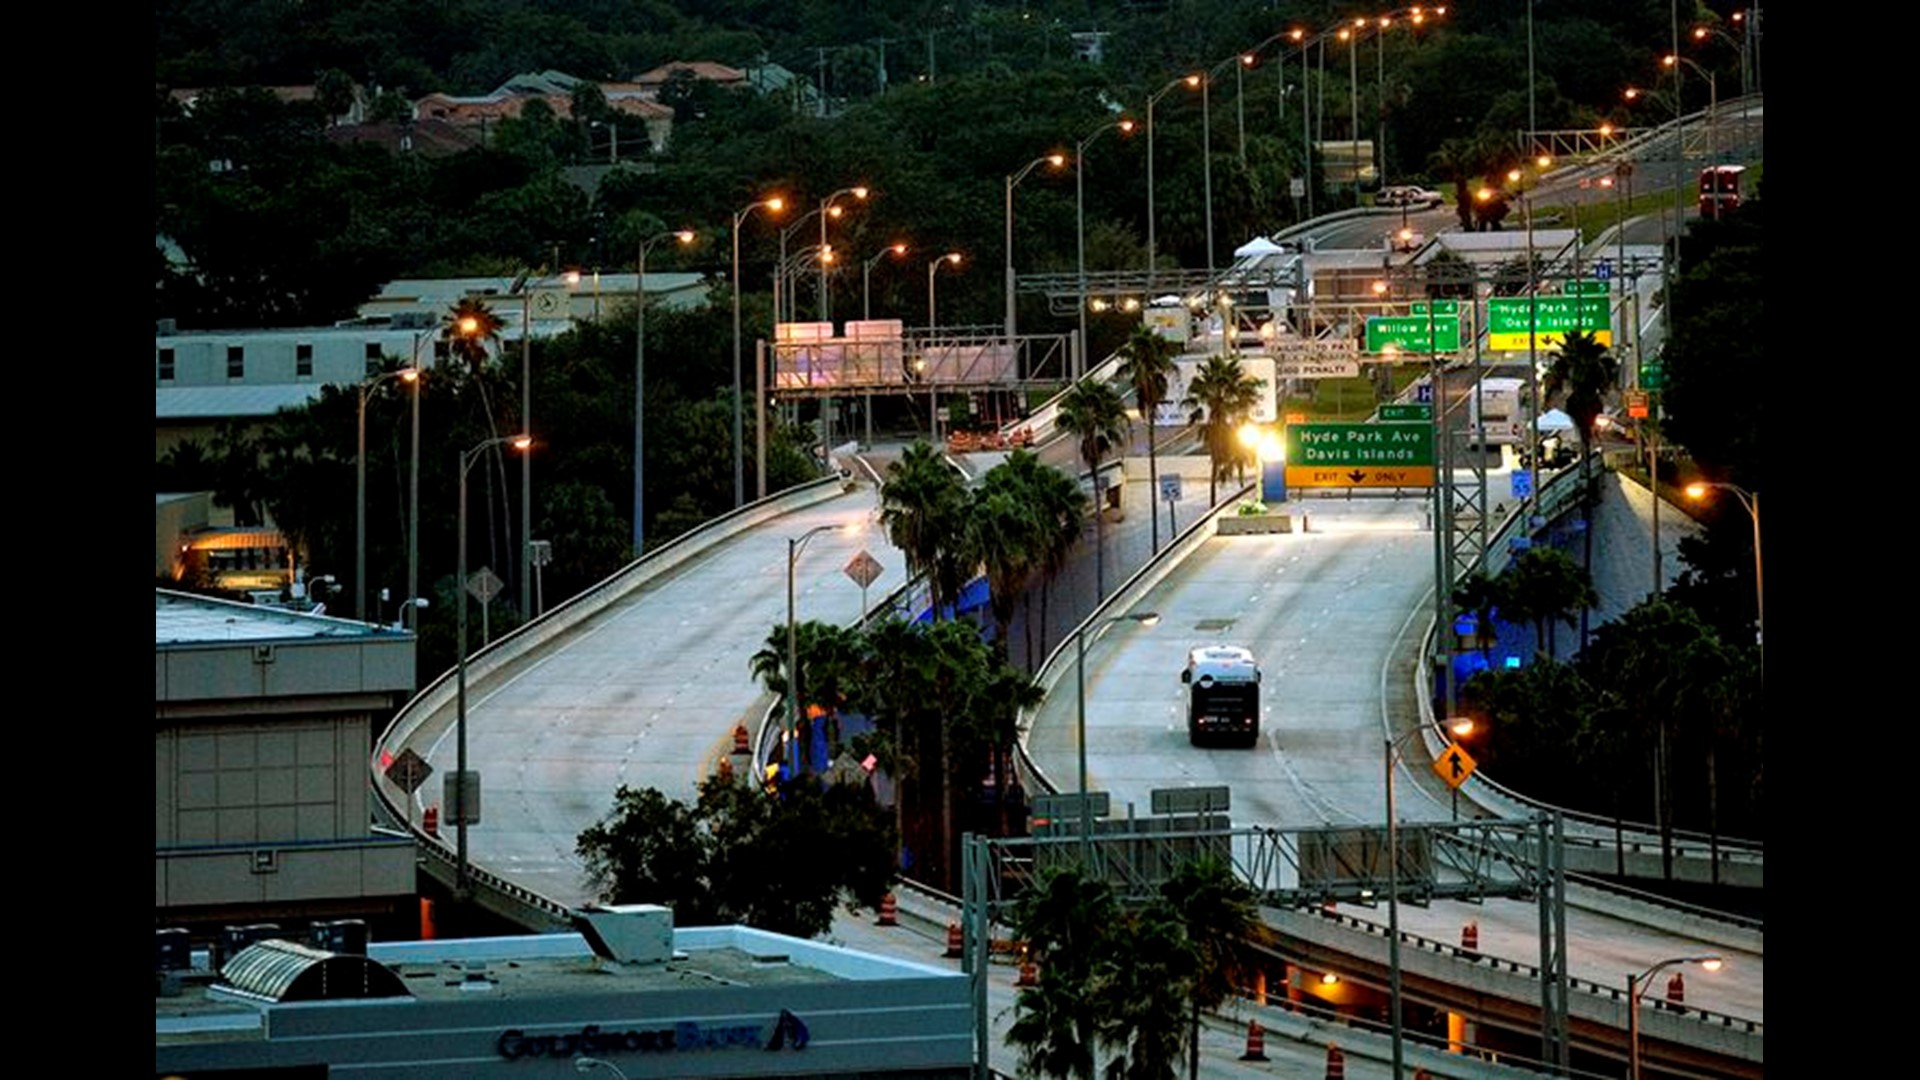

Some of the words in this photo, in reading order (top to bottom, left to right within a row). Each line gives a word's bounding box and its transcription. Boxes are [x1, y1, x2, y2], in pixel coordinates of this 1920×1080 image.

[1539, 303, 1568, 313] Park
[1506, 317, 1541, 327] Davs
[1377, 324, 1418, 333] Willow
[1384, 408, 1404, 417] EXIT
[1420, 407, 1430, 418] 5
[1300, 431, 1340, 444] Hyde
[1346, 430, 1383, 442] Park
[1391, 431, 1421, 442] Ave
[1306, 447, 1350, 459] Davis
[1357, 447, 1414, 459] Islands
[1314, 472, 1338, 481] EXIT
[1375, 472, 1406, 481] ONLY
